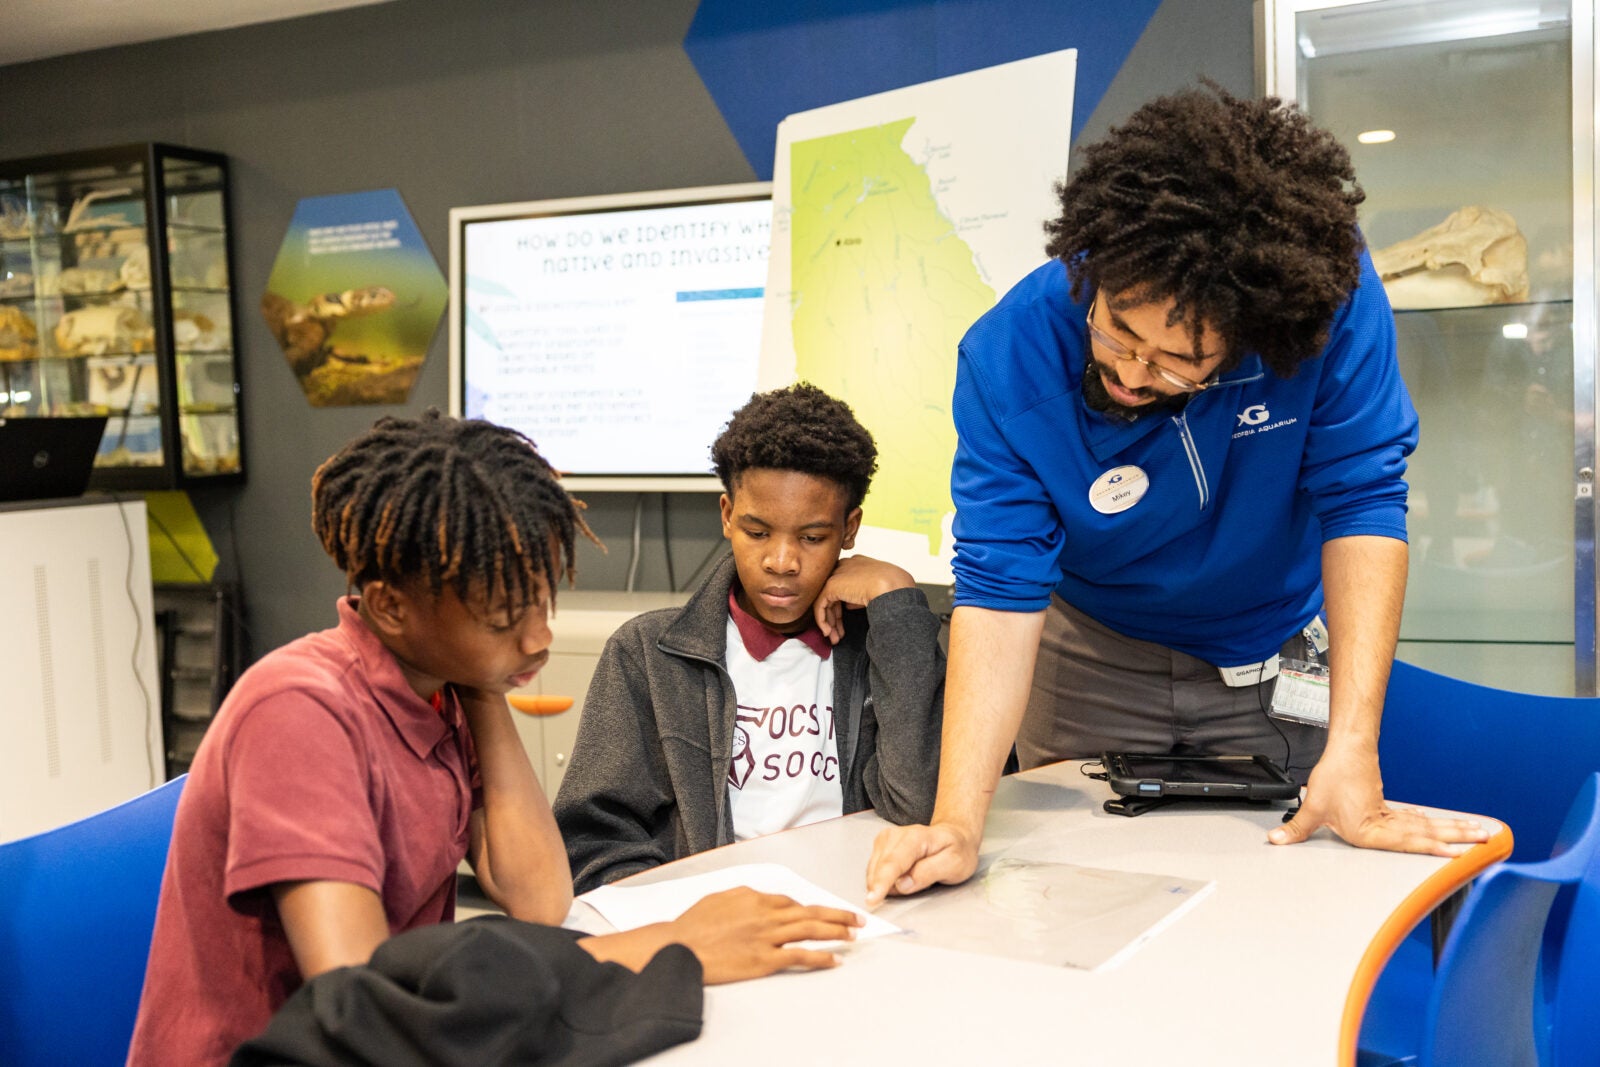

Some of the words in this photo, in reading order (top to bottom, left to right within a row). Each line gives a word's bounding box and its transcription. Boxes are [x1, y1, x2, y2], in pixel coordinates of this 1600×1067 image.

[567, 231, 593, 247] DO
[1258, 417, 1297, 432] AQUARIUM
[1112, 490, 1131, 502] Mikey
[763, 751, 838, 781] SOCC
